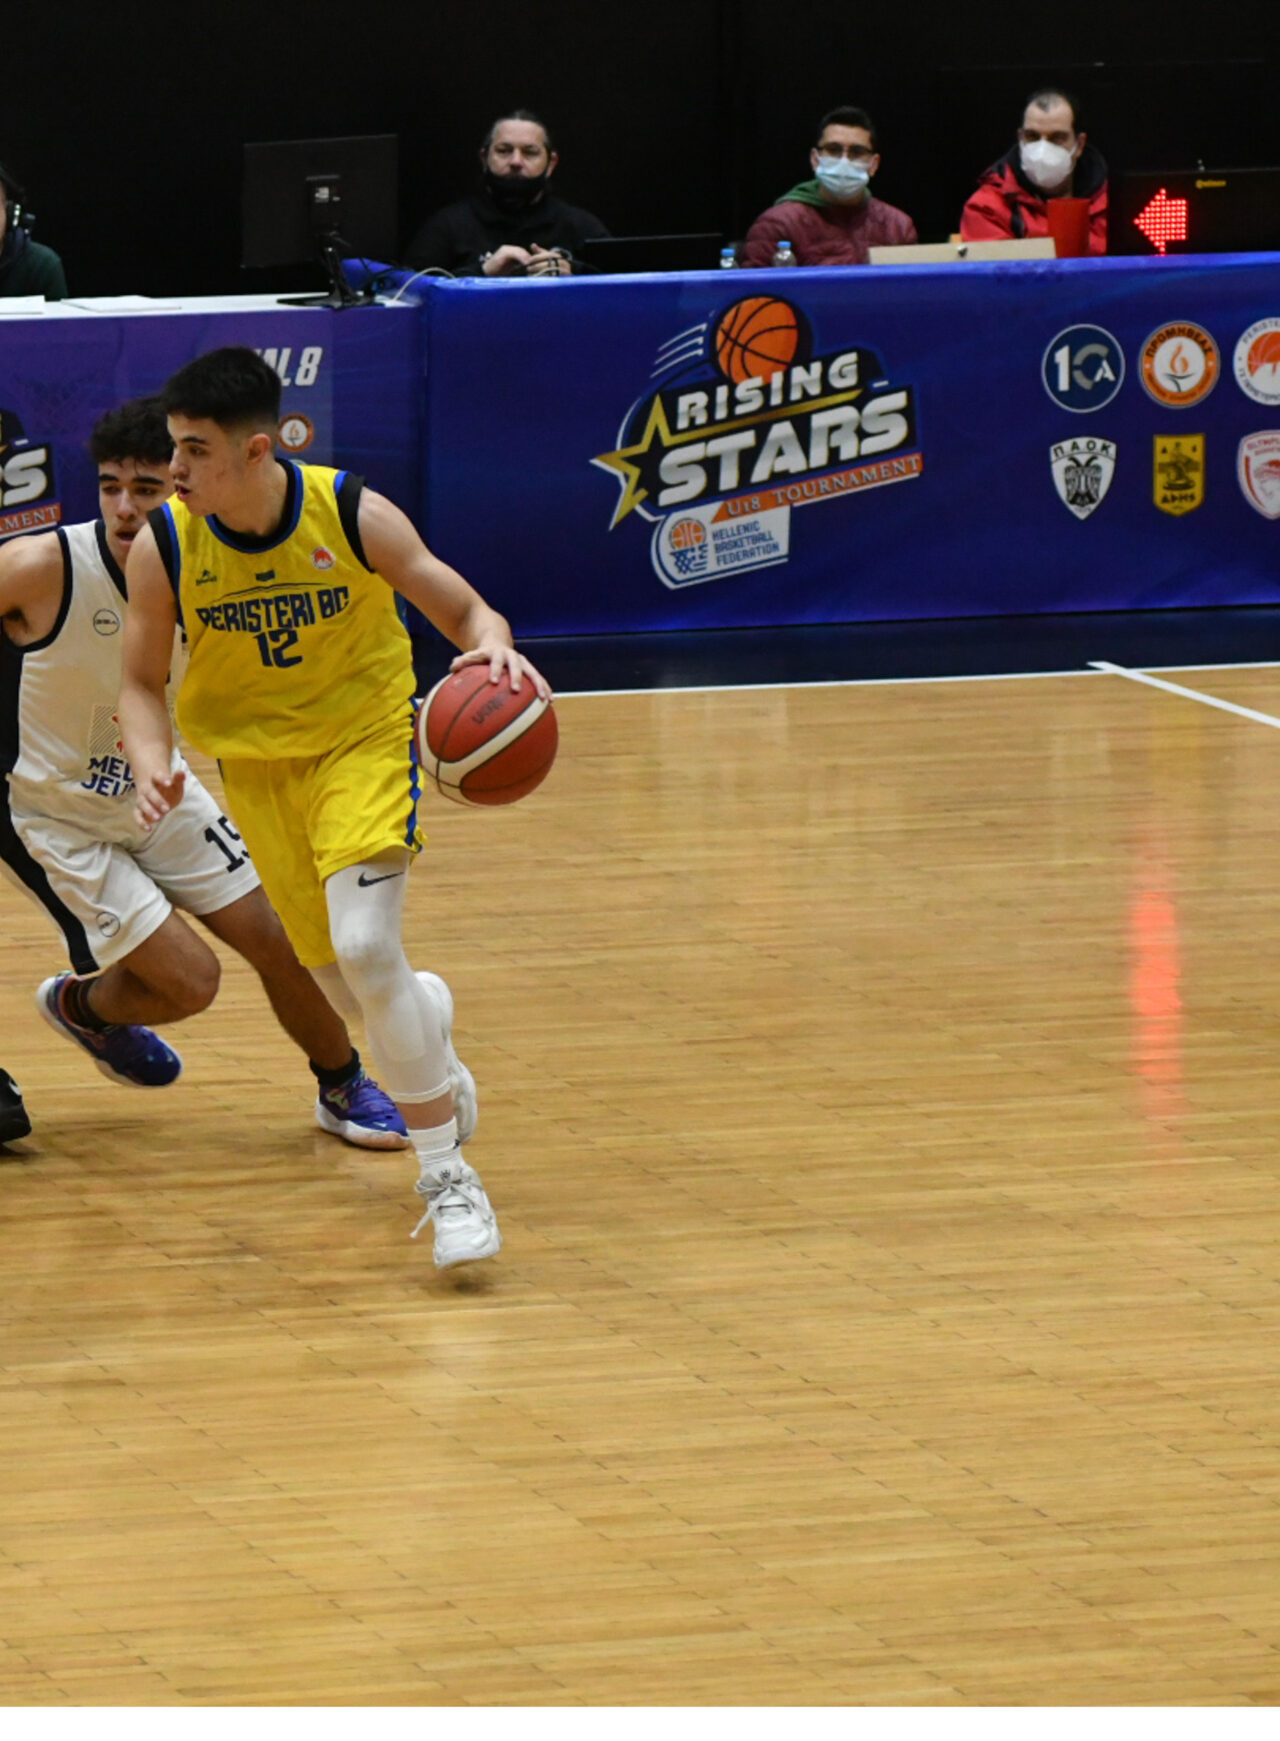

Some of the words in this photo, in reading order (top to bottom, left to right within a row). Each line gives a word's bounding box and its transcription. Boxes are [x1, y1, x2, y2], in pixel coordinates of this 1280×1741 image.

[295, 346, 323, 386] 8
[676, 352, 858, 430] RISING
[658, 391, 908, 507] STARS
[1053, 440, 1111, 457] ΠΑΟΚ
[726, 496, 762, 517] U18
[773, 456, 921, 505] TOURNAMENT
[712, 520, 760, 541] HELLENIC
[714, 530, 774, 554] BASKETBALL
[717, 542, 780, 566] FEDERATION
[196, 592, 315, 633] PERISTERI
[316, 586, 350, 619] BC
[254, 628, 303, 668] 12
